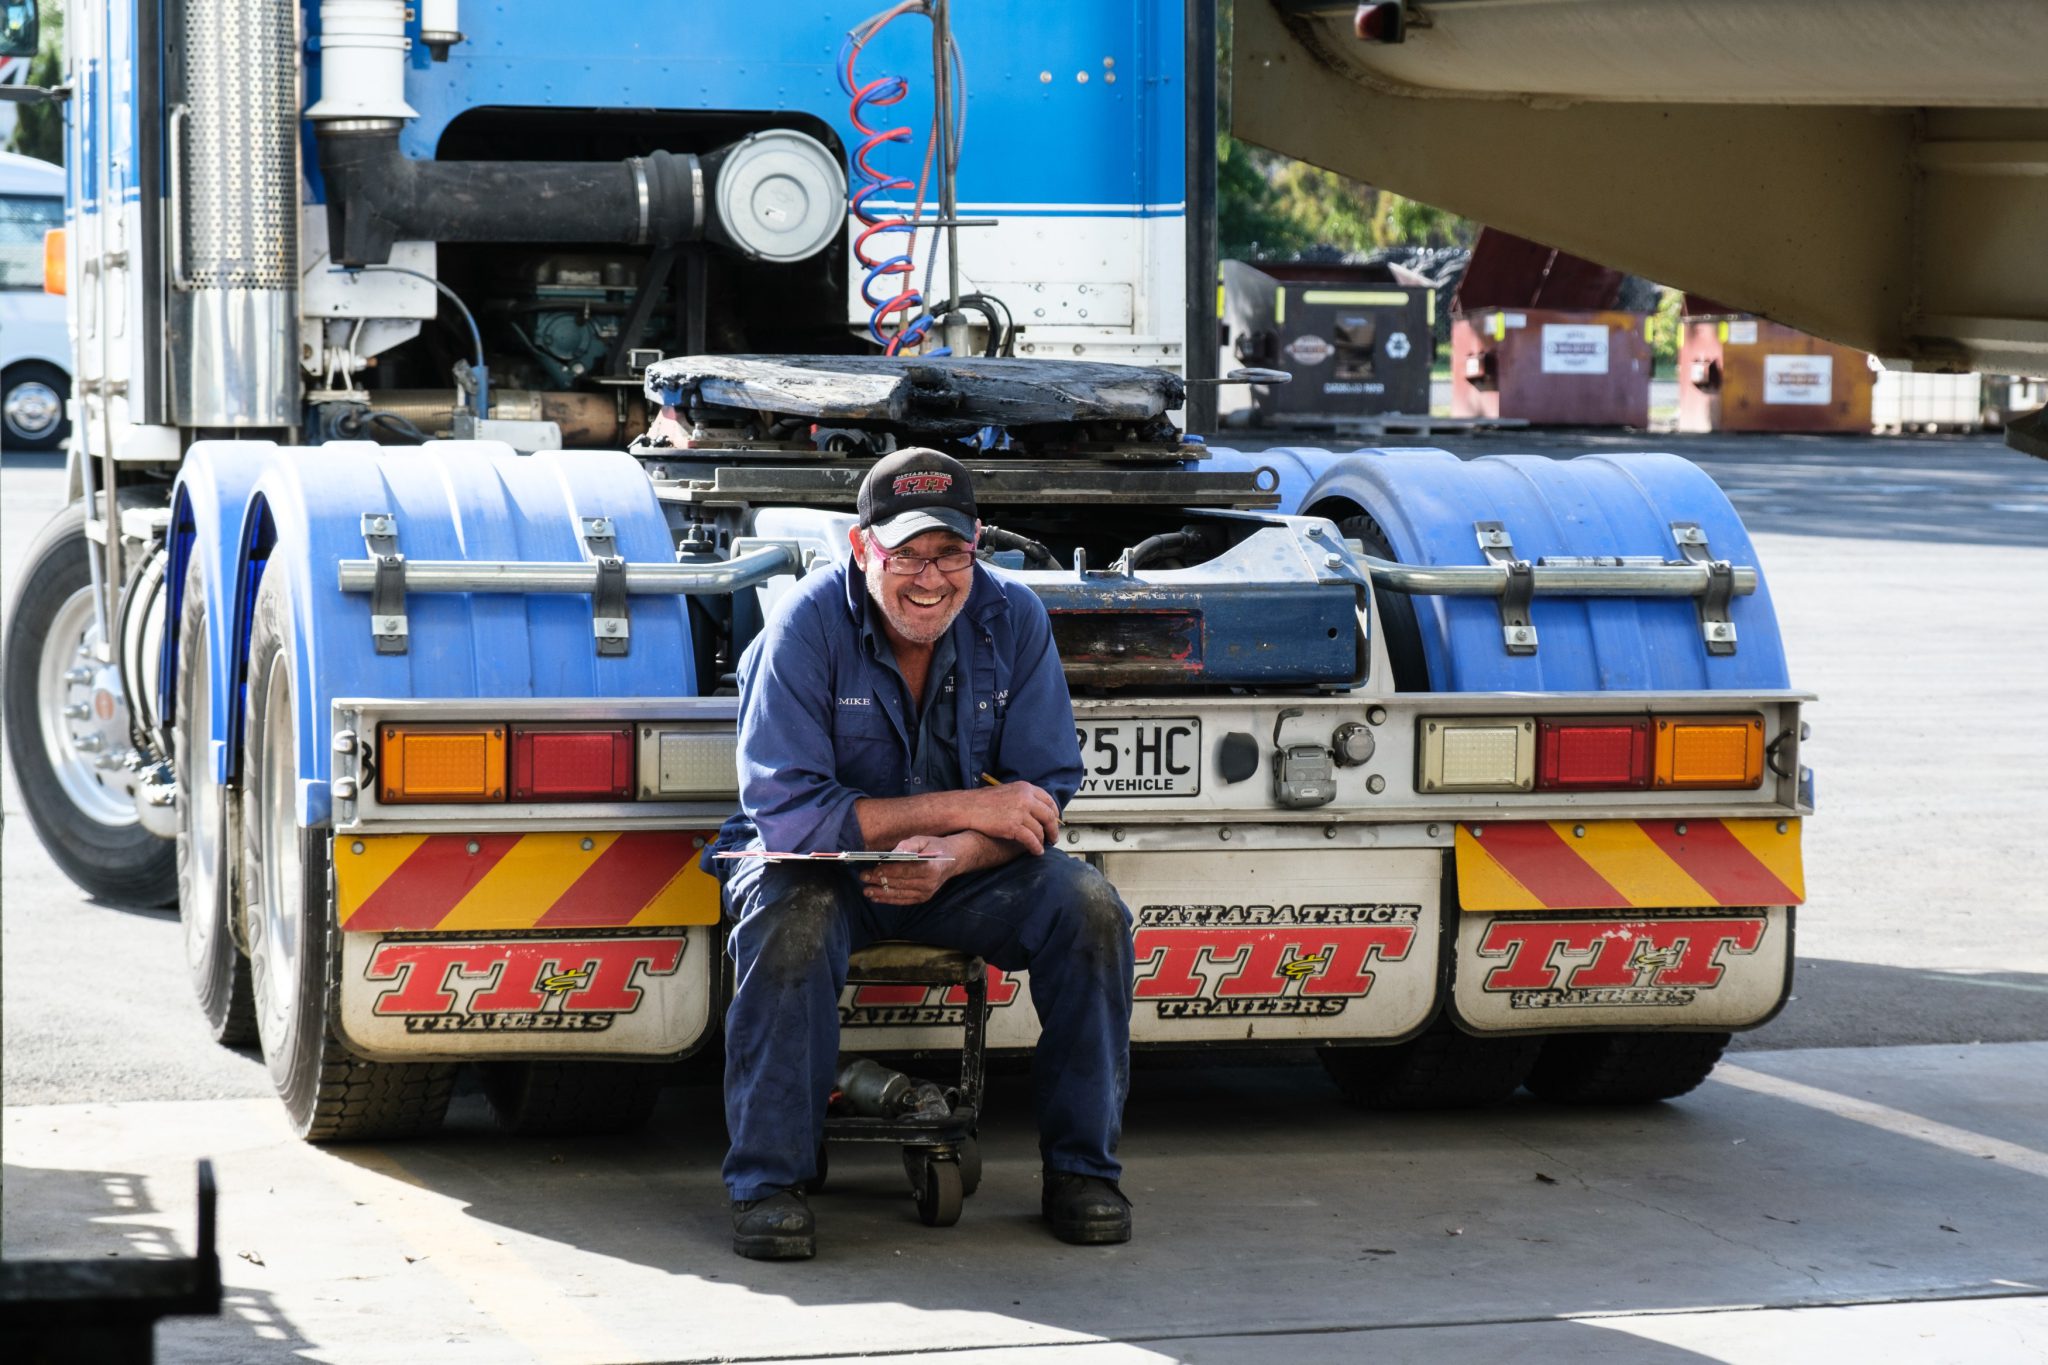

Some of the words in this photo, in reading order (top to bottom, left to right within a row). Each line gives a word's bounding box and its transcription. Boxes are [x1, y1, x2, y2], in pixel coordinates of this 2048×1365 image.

[838, 697, 870, 706] MIKE
[1104, 779, 1173, 791] VEHICLE
[1143, 906, 1298, 925] TATIARA
[1300, 905, 1419, 922] TRUCK
[1160, 1000, 1346, 1016] TRAILERS
[407, 1014, 612, 1030] TRAILERS
